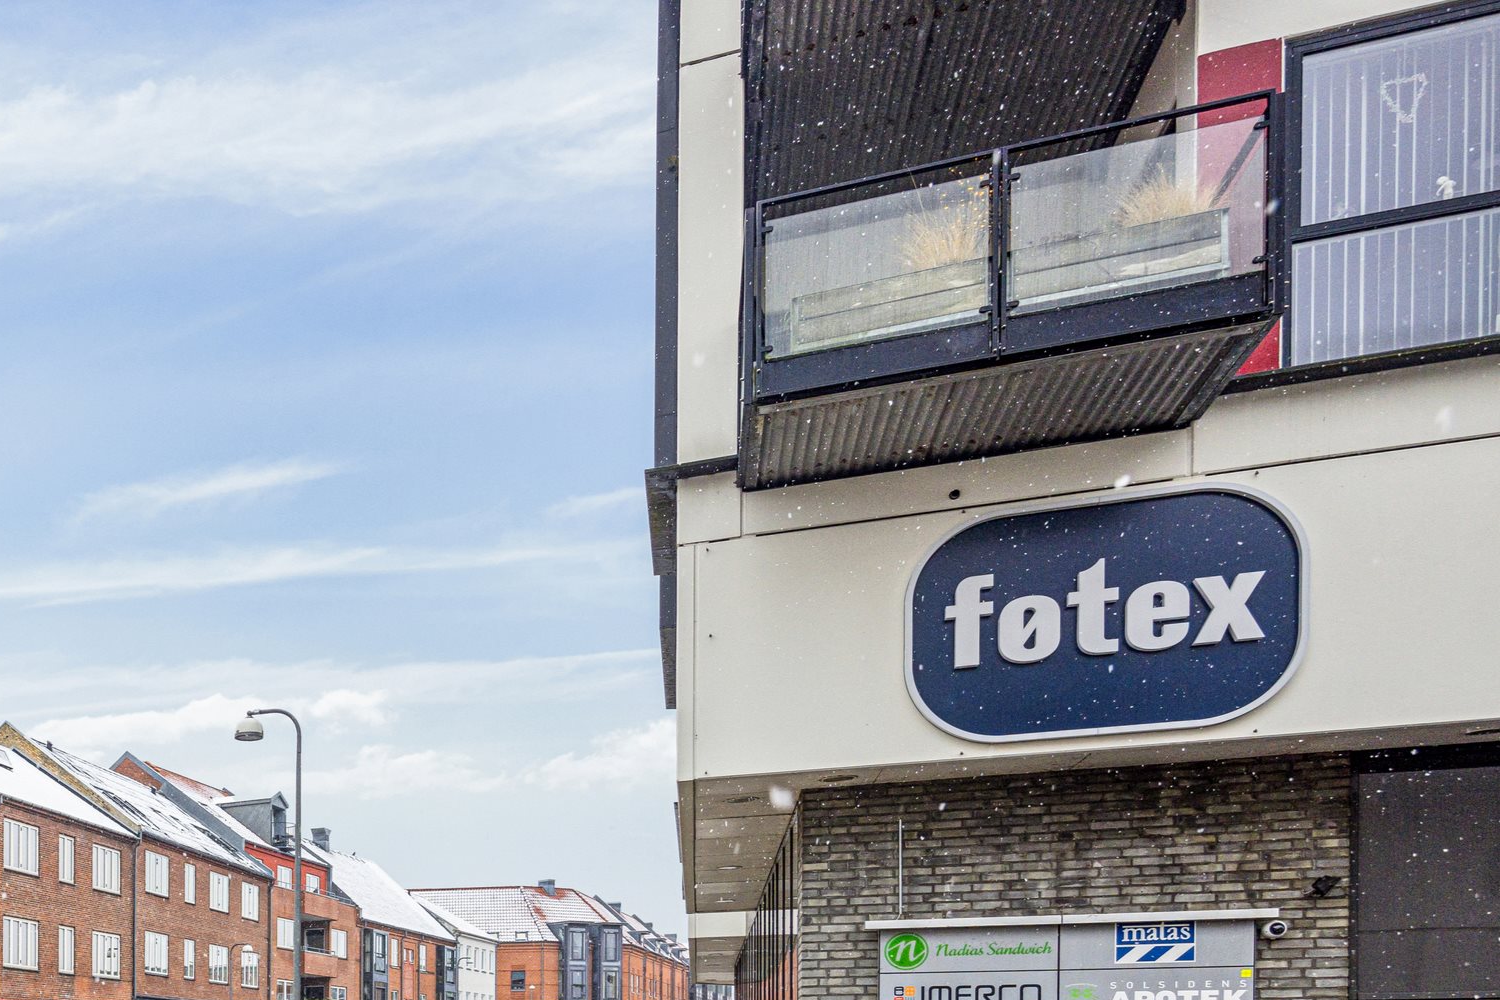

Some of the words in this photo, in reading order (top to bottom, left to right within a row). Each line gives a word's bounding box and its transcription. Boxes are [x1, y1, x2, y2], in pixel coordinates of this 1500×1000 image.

[944, 558, 1266, 669] føtex
[1120, 922, 1192, 942] matas
[935, 943, 984, 957] Nadias
[986, 941, 1052, 956] Sandwich
[1109, 979, 1248, 990] SOLSIDENS
